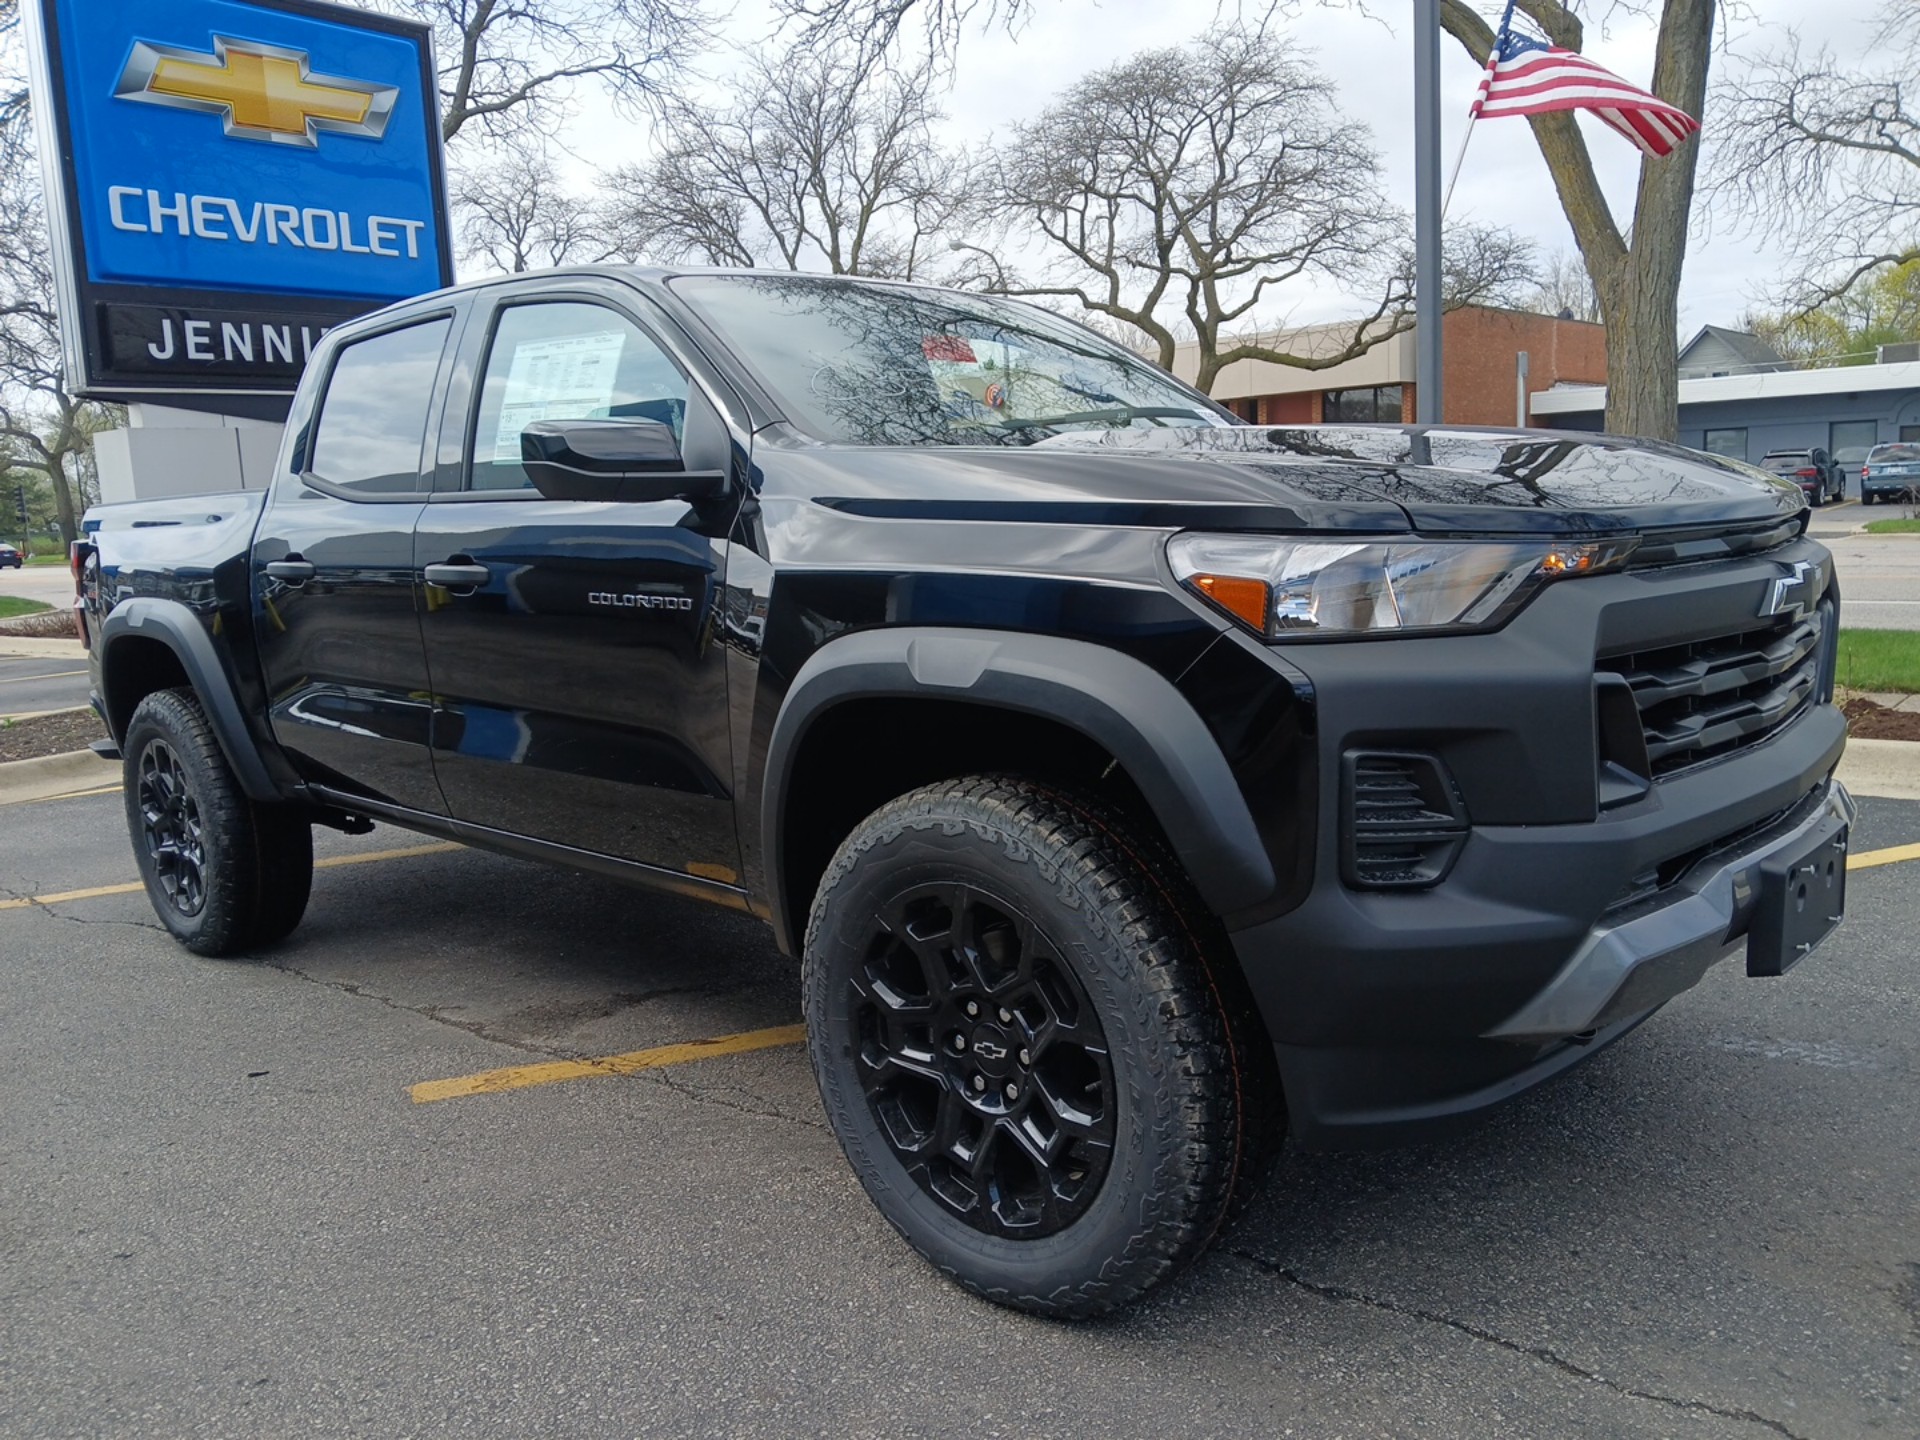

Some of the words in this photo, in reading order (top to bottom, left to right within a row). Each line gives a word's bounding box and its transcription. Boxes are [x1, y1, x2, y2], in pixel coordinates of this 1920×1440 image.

[108, 185, 425, 258] CHEVROLET
[147, 318, 330, 364] JENNI
[588, 592, 692, 610] COLORADO
